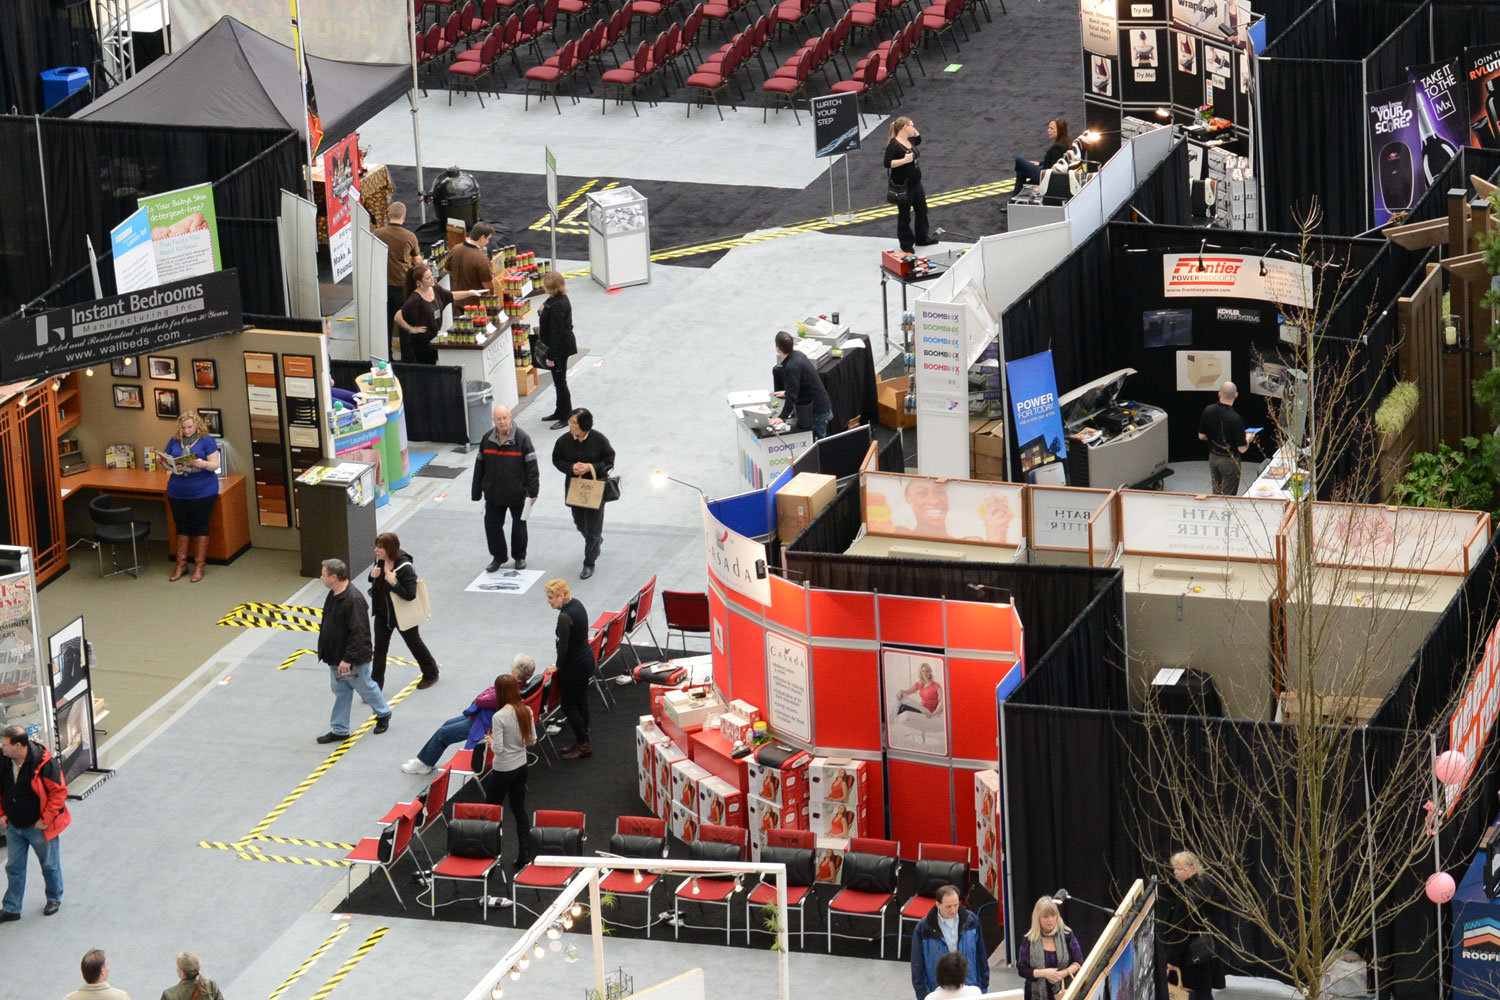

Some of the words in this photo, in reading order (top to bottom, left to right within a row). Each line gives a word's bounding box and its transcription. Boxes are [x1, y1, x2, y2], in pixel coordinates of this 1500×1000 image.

[1133, 6, 1142, 15] Try
[1088, 17, 1100, 25] Back
[1088, 24, 1099, 32] Total
[1473, 53, 1493, 68] JOIN
[1420, 70, 1444, 89] TAKE
[1441, 63, 1451, 76] IT
[1424, 85, 1439, 99] TO
[1436, 74, 1457, 92] THE
[816, 99, 842, 109] WATCH
[1435, 100, 1451, 114] Mx
[816, 108, 837, 117] YOUR
[1376, 106, 1403, 122] YOUR
[817, 117, 835, 127] STEP
[1375, 110, 1413, 135] SCORE?
[155, 202, 171, 211] Your
[193, 194, 207, 202] Skin
[1173, 261, 1242, 275] Frontier
[71, 298, 125, 325] Instant
[129, 283, 204, 312] Bedrooms
[82, 309, 170, 334] Manufacturing
[176, 303, 198, 312] Inc.
[65, 348, 96, 362] www.
[99, 336, 150, 355] wallbeds
[1016, 392, 1054, 412] POWER
[1017, 407, 1032, 419] FOR
